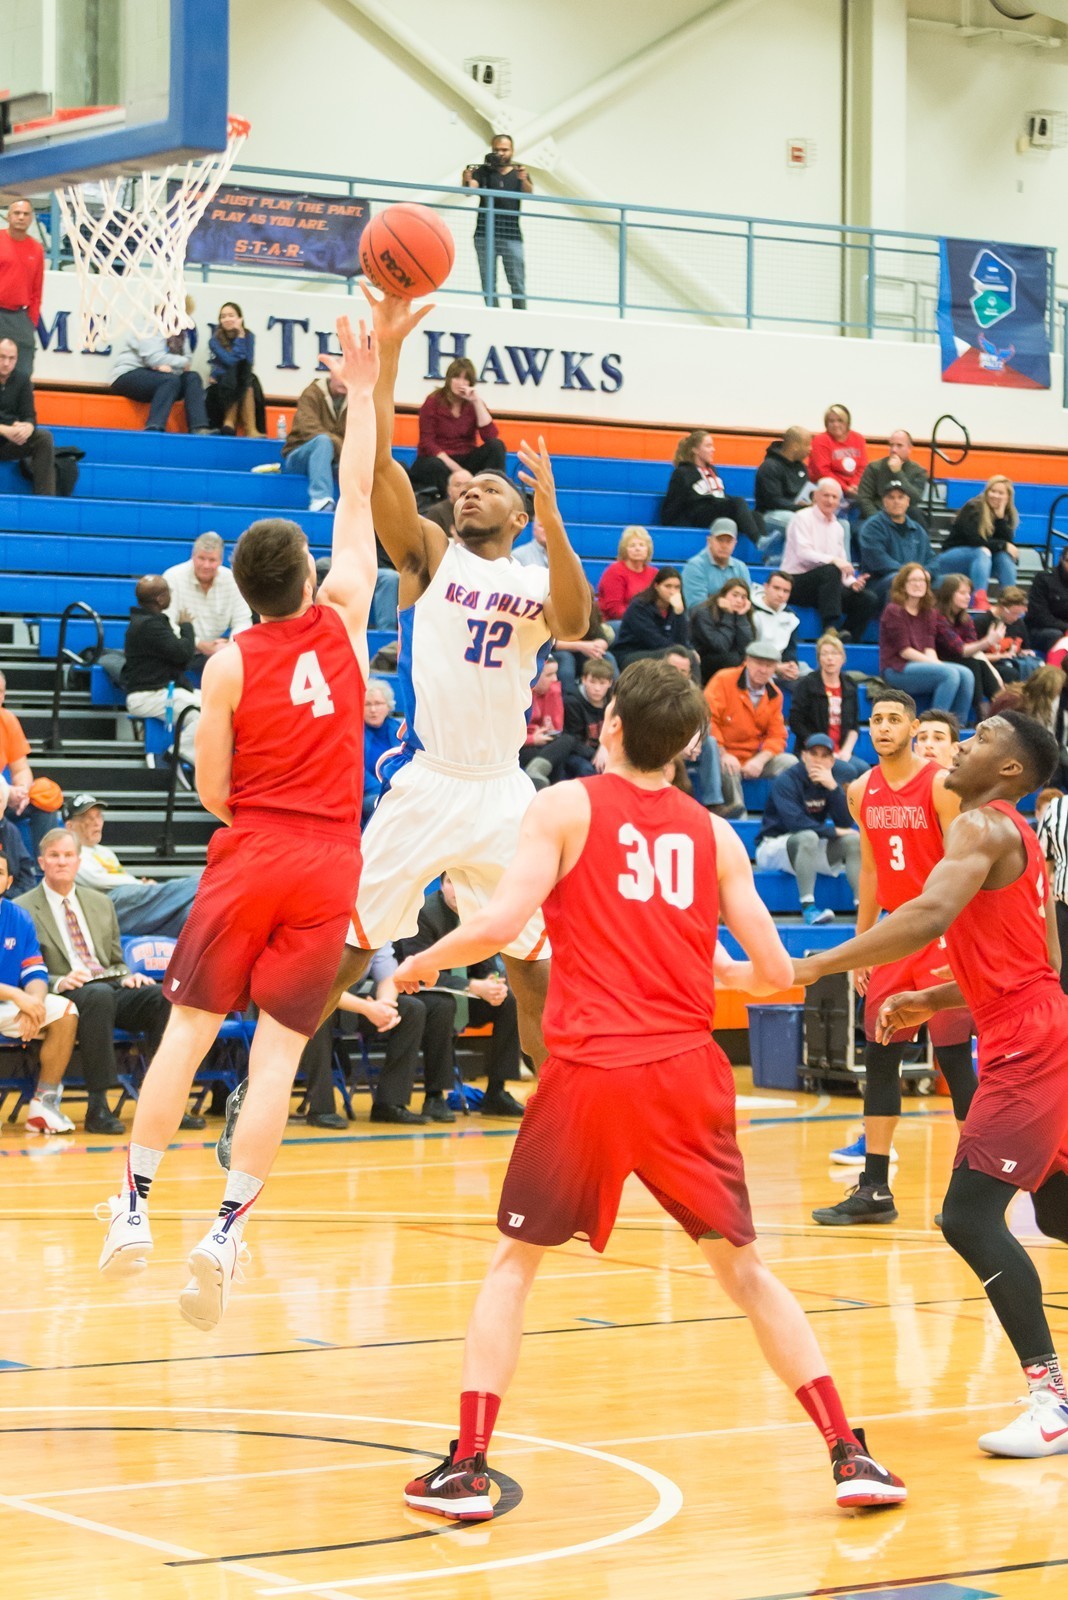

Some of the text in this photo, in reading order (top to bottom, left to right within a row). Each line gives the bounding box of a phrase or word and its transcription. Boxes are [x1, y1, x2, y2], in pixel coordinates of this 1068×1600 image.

[211, 209, 246, 223] PLAY
[247, 213, 267, 225] AS
[269, 216, 296, 228] YOU
[219, 193, 258, 207] JUST
[259, 197, 293, 211] PLAY
[297, 202, 325, 215] THE
[380, 248, 416, 289] NCAA
[423, 330, 625, 393] HAWKS
[485, 592, 544, 621] PALTZ
[464, 618, 514, 669] 32
[289, 649, 336, 719] 4
[866, 806, 928, 830] ONEONTA
[618, 822, 695, 911] 30
[889, 835, 906, 871] 3
